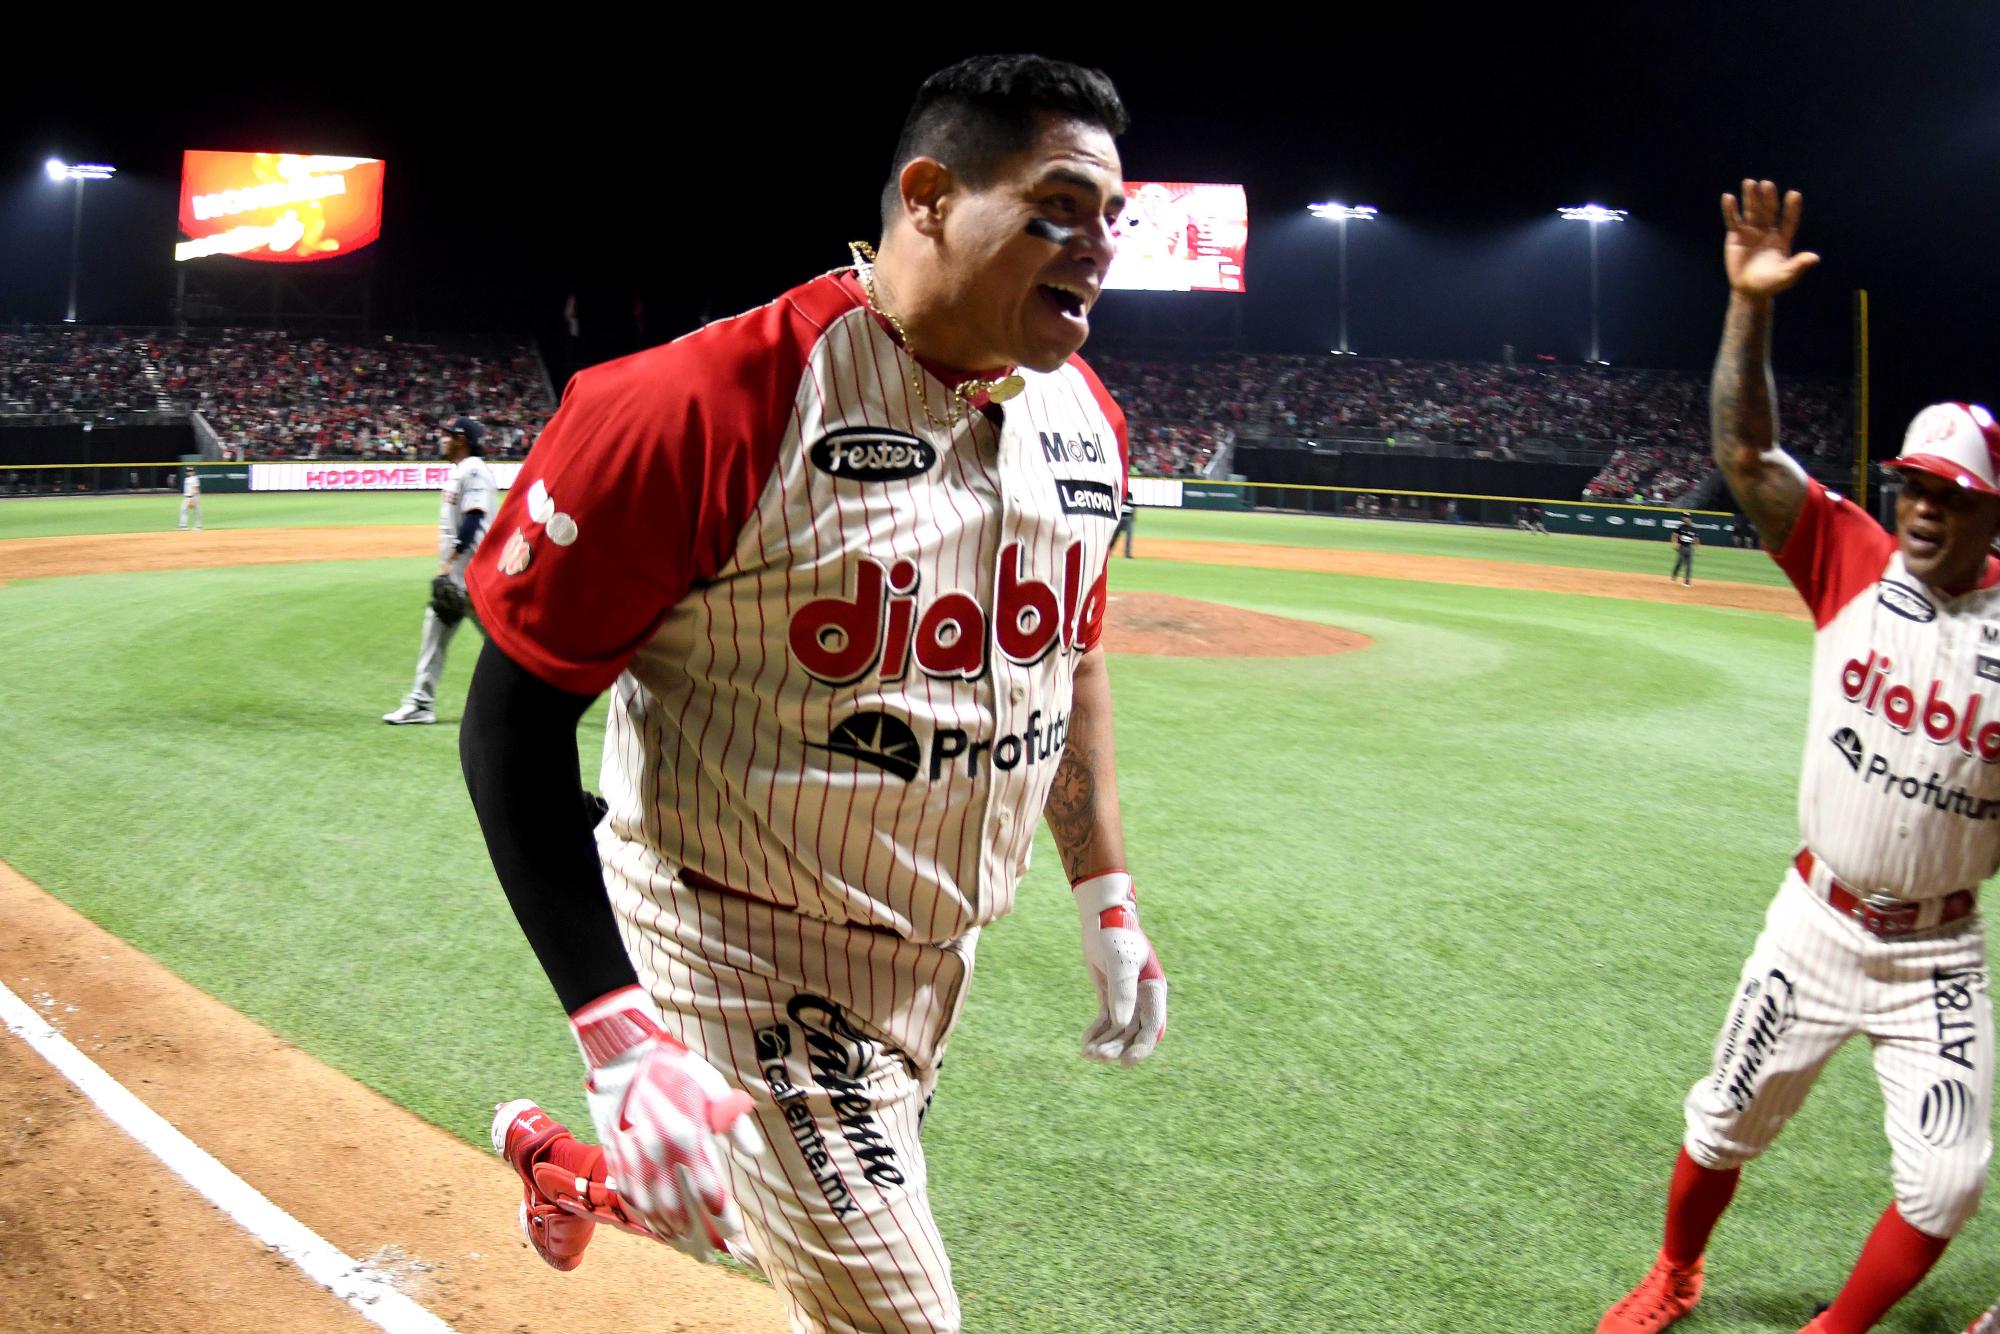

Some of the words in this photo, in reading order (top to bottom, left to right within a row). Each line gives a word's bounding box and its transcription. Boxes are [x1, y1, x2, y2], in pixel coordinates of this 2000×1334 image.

[825, 433, 926, 472] Fester
[1039, 431, 1106, 464] Mobil
[1061, 485, 1112, 512] Lenovo
[765, 1063, 859, 1219] calente.mx
